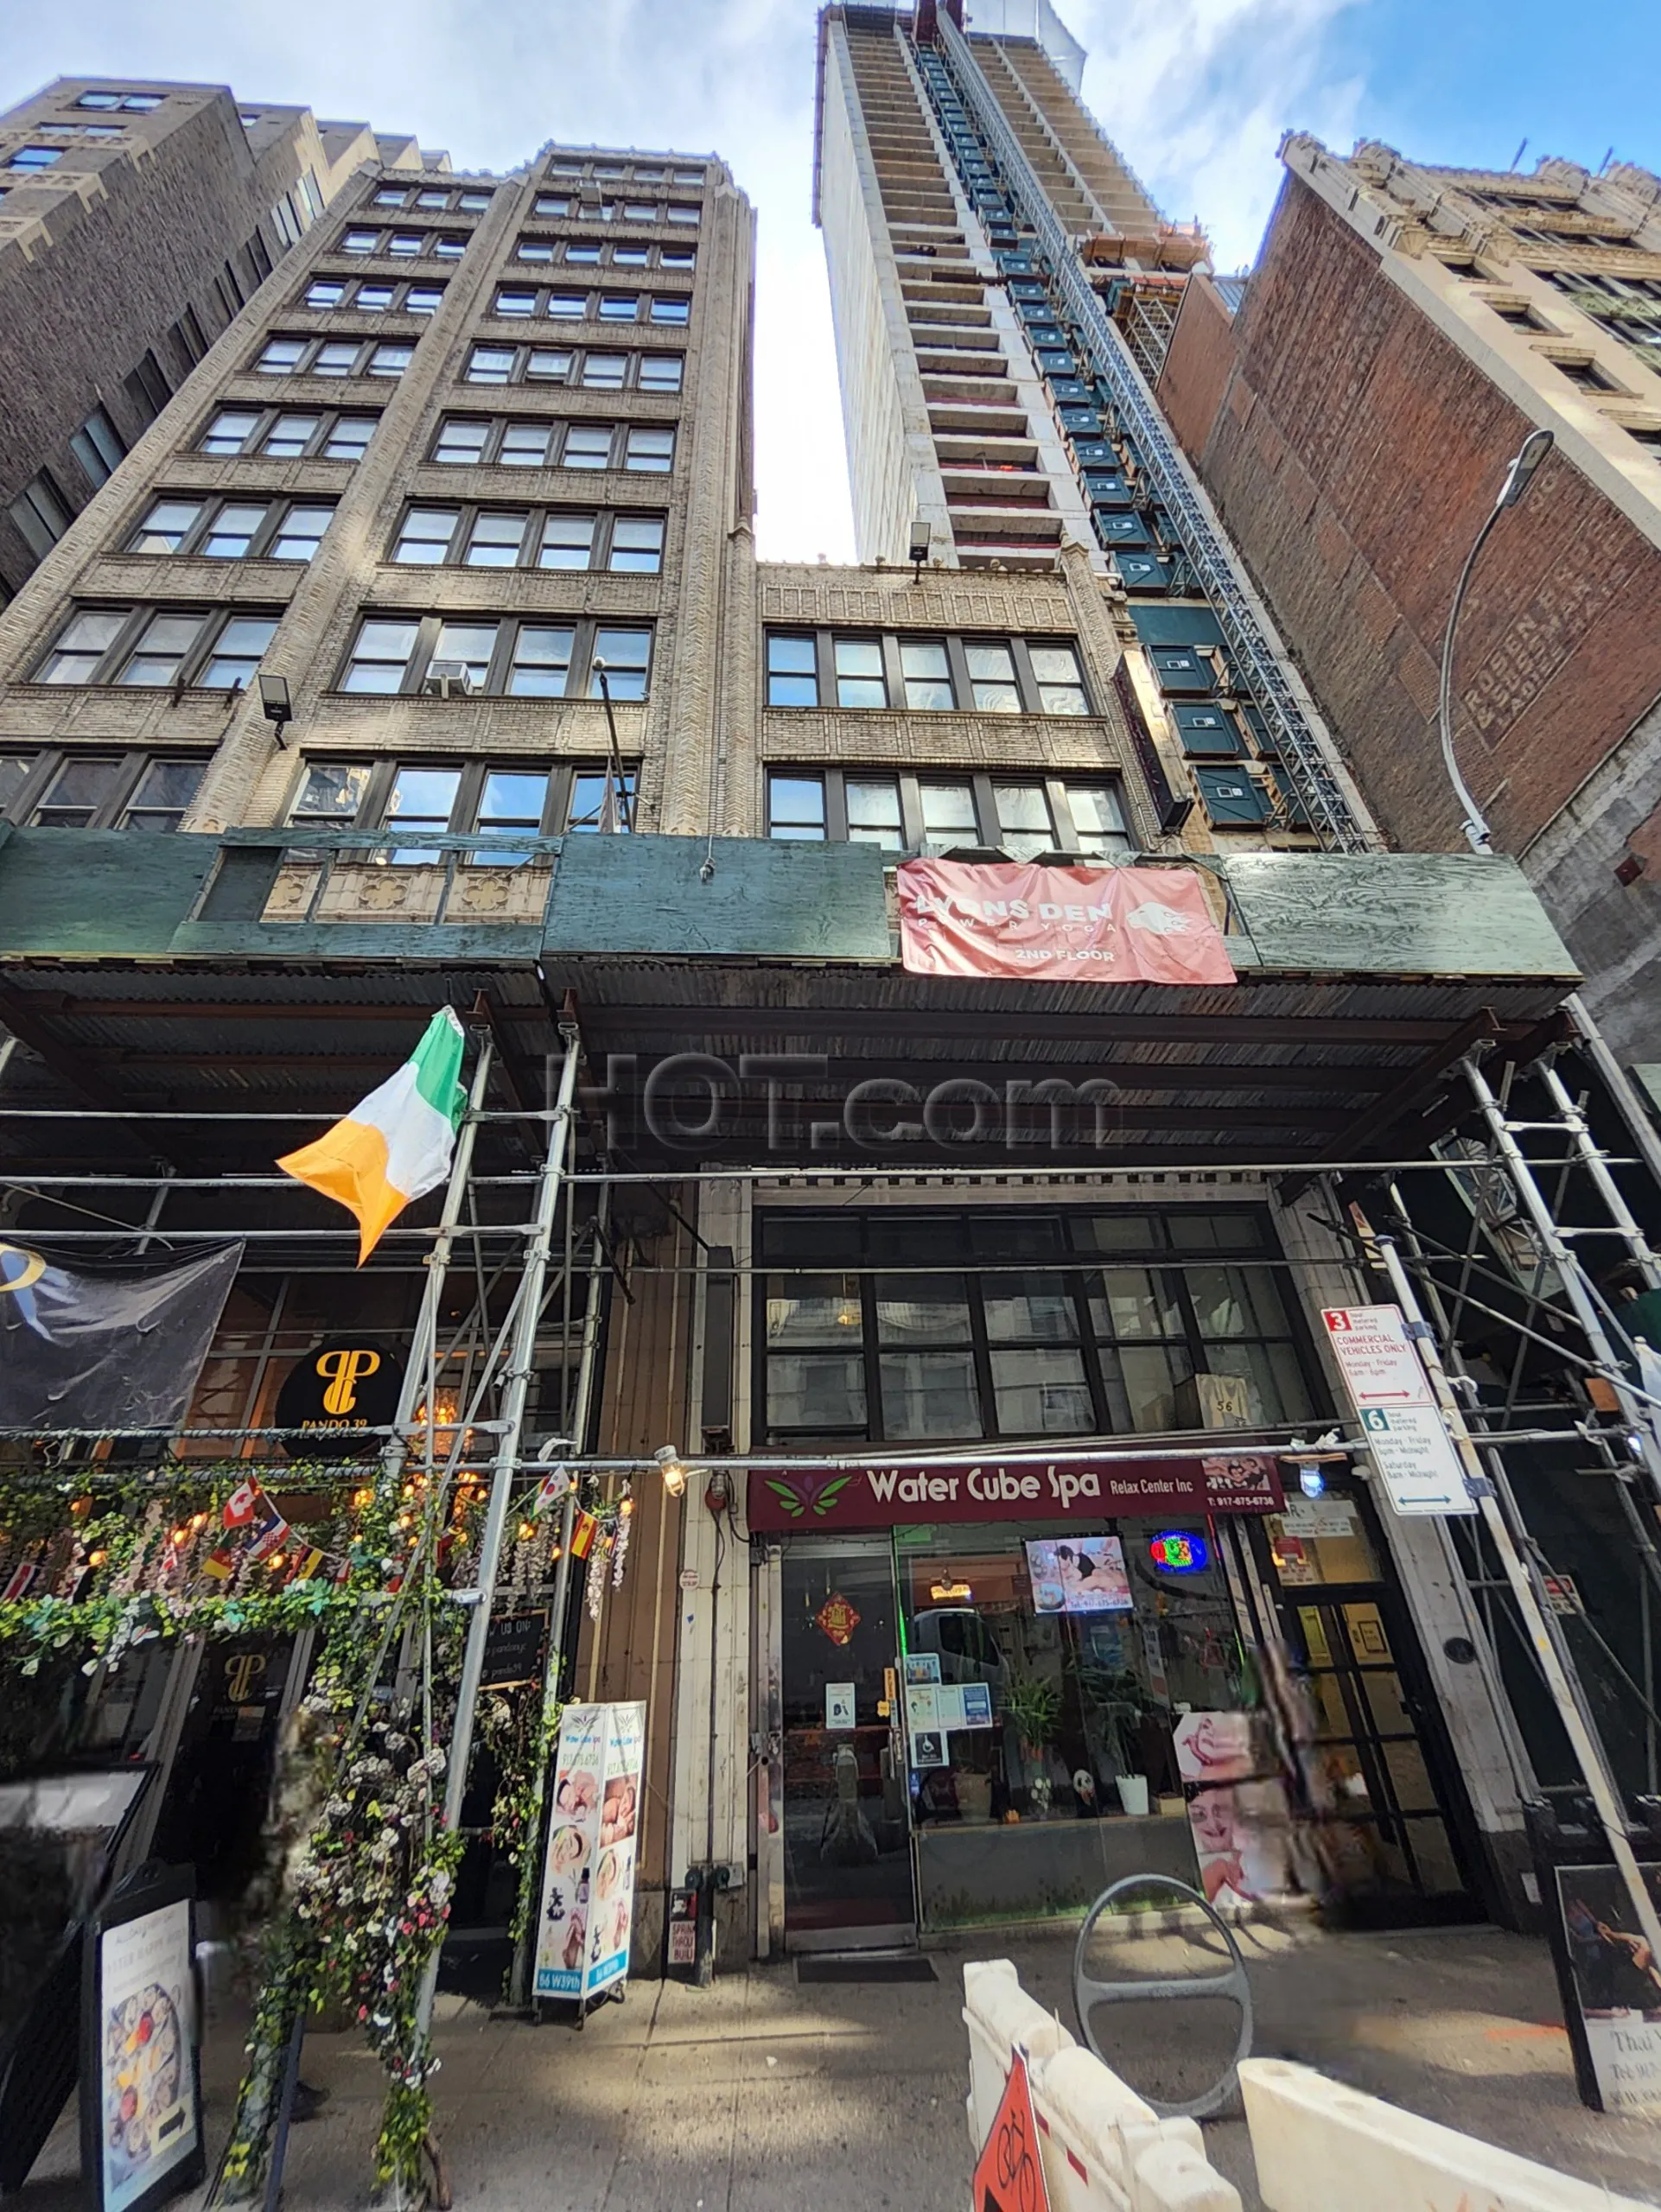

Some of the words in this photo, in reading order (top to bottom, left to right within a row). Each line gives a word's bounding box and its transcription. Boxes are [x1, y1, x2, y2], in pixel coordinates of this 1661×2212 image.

[1039, 902, 1113, 922] DEN
[1041, 922, 1117, 933] YOGA
[1016, 949, 1052, 961] 2ND
[1055, 950, 1115, 962] FLOOR
[1331, 1313, 1346, 1331] 3
[1337, 1333, 1395, 1345] COMMERCIAL
[1340, 1345, 1383, 1356] VEHICLES
[1384, 1344, 1407, 1354] ONLY
[1346, 1359, 1371, 1368] Monday
[1377, 1358, 1397, 1367] Friday
[1368, 1410, 1384, 1430] 6
[1383, 1461, 1416, 1470] Saturday
[867, 1469, 959, 1503] Water
[967, 1467, 1041, 1501] Cube
[1047, 1465, 1100, 1508] Spa
[1111, 1480, 1138, 1495] Relax
[1140, 1479, 1174, 1494] Center
[1175, 1478, 1193, 1492] Inc
[1610, 2029, 1652, 2052] Thai
